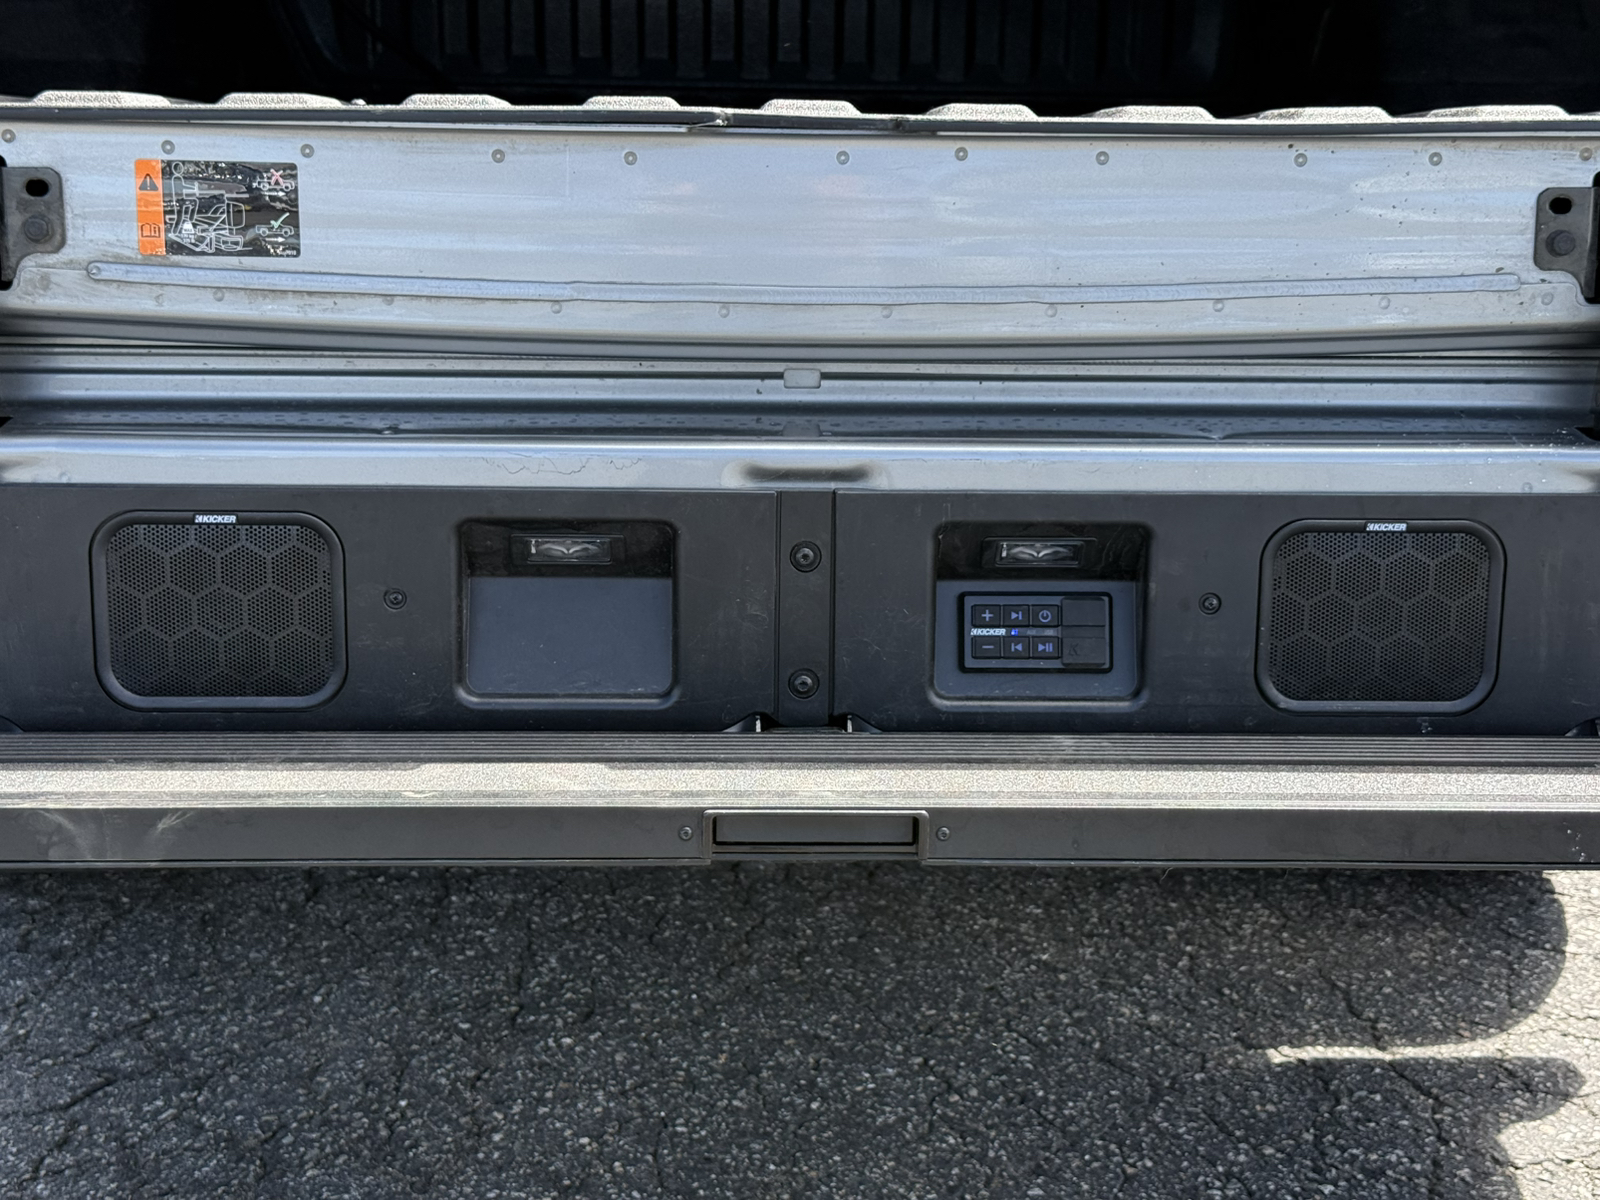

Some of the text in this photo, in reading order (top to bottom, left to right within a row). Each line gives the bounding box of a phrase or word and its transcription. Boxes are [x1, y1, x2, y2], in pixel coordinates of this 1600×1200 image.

[202, 515, 237, 523] KICKER
[1373, 523, 1407, 531] KICKER
[977, 628, 1006, 636] KICKER
